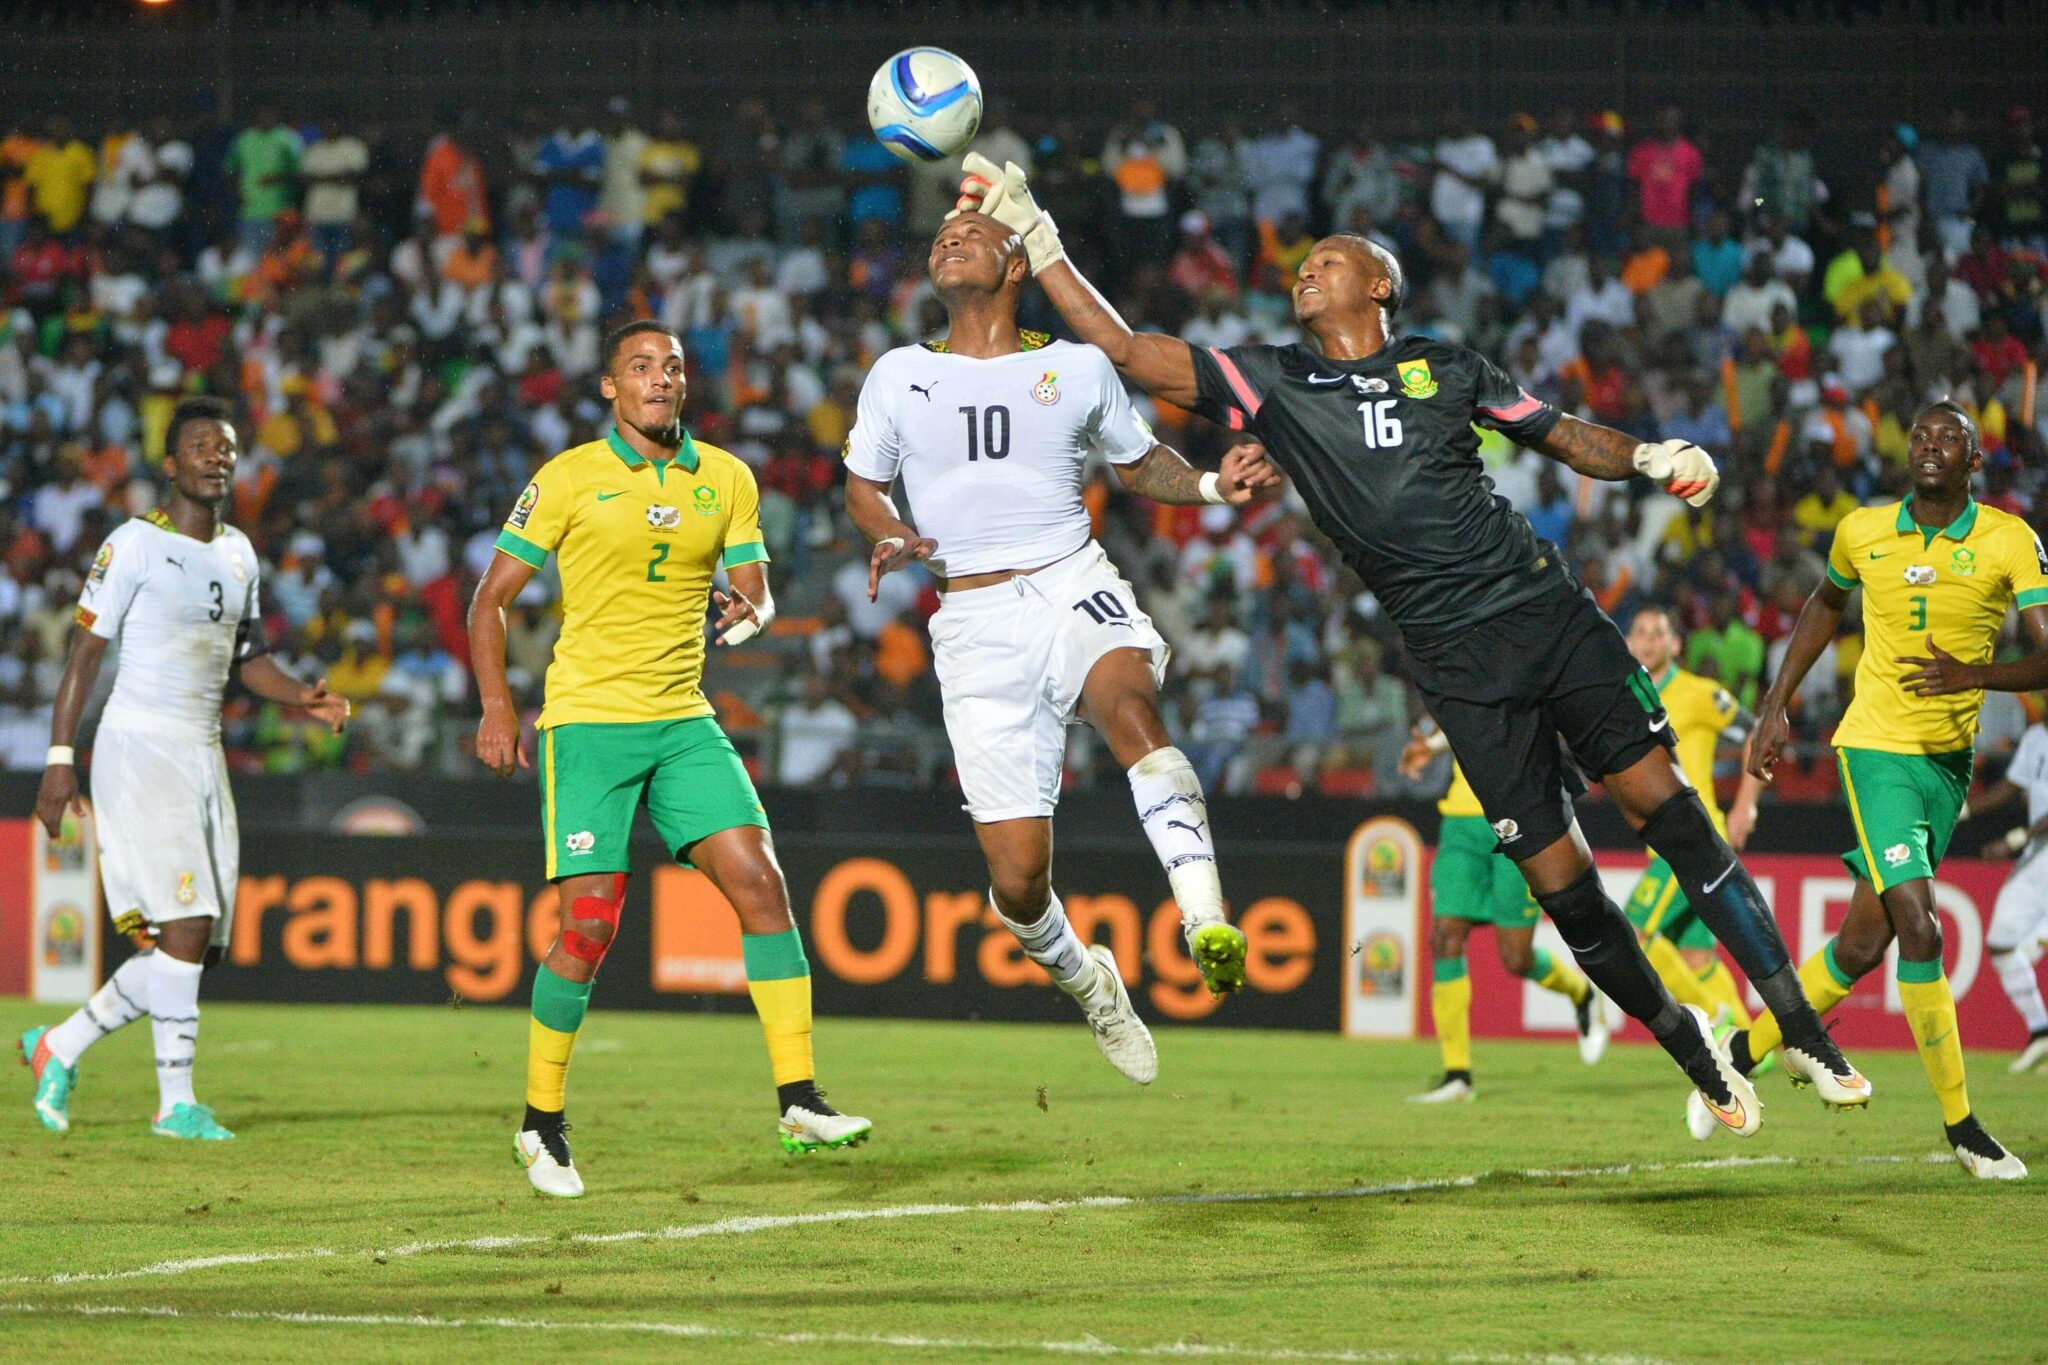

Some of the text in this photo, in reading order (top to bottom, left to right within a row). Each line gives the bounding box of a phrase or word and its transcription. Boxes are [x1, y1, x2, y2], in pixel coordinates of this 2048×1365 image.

[958, 404, 1010, 461] 10
[1357, 399, 1403, 449] 16
[646, 543, 670, 582] 2
[209, 580, 223, 622] 3
[1072, 590, 1129, 625] 10
[1908, 595, 1927, 631] 3
[133, 874, 561, 1002] rang
